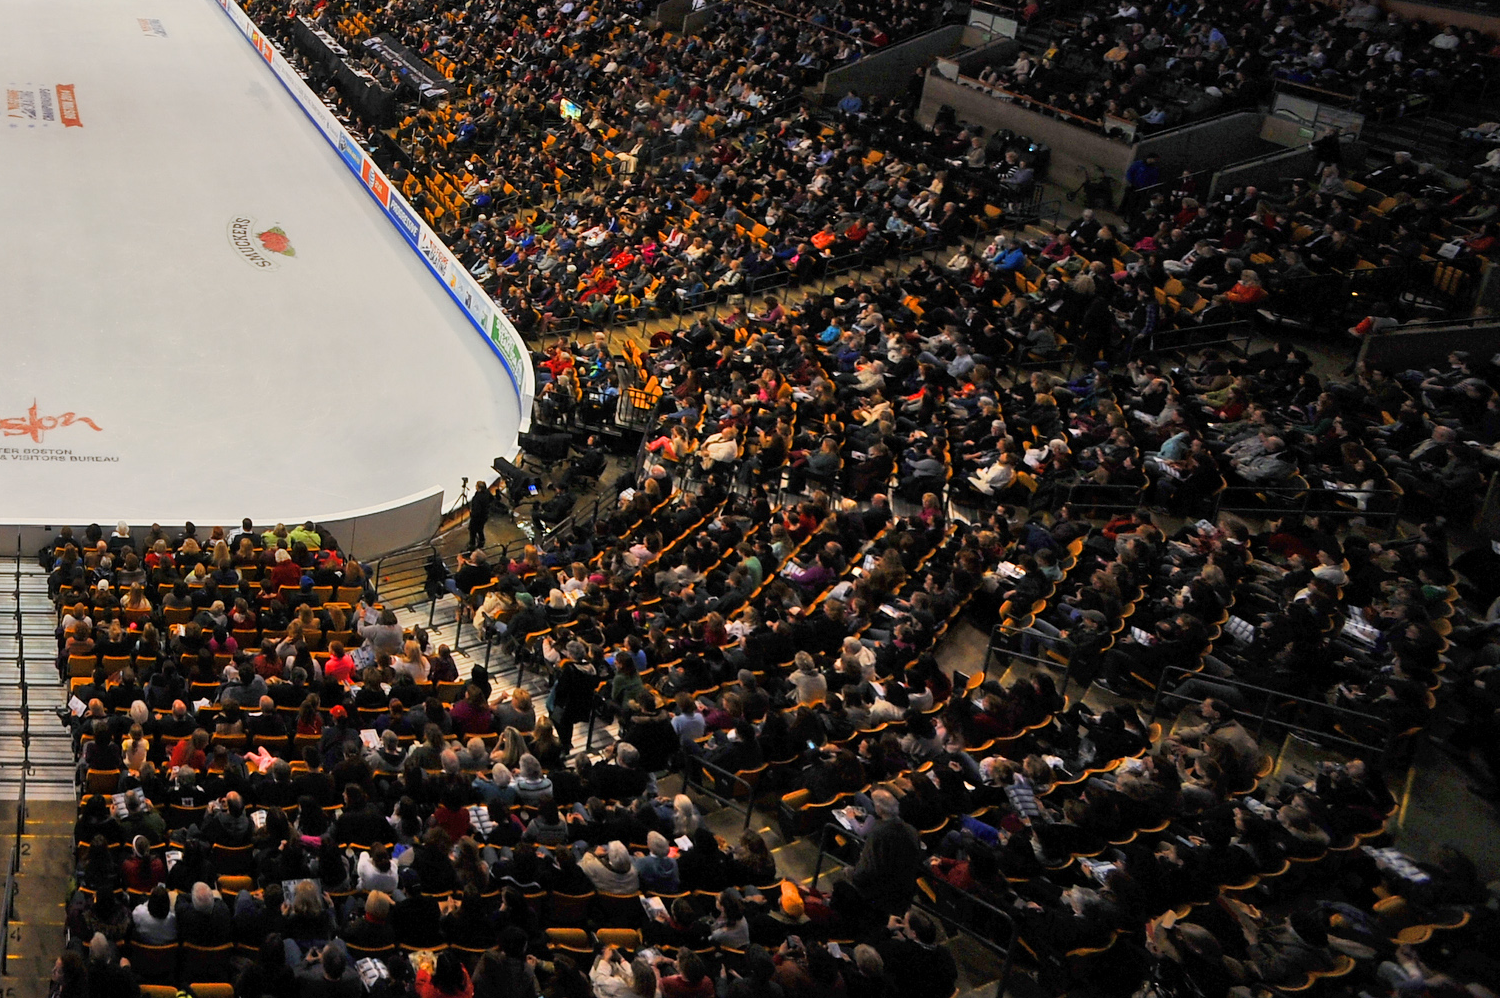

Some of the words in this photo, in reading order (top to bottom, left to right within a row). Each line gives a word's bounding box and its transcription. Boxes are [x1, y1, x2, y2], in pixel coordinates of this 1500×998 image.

[390, 196, 419, 237] PROGRESSIVE
[11, 454, 66, 462] VISITORS
[69, 455, 120, 463] BUREAU
